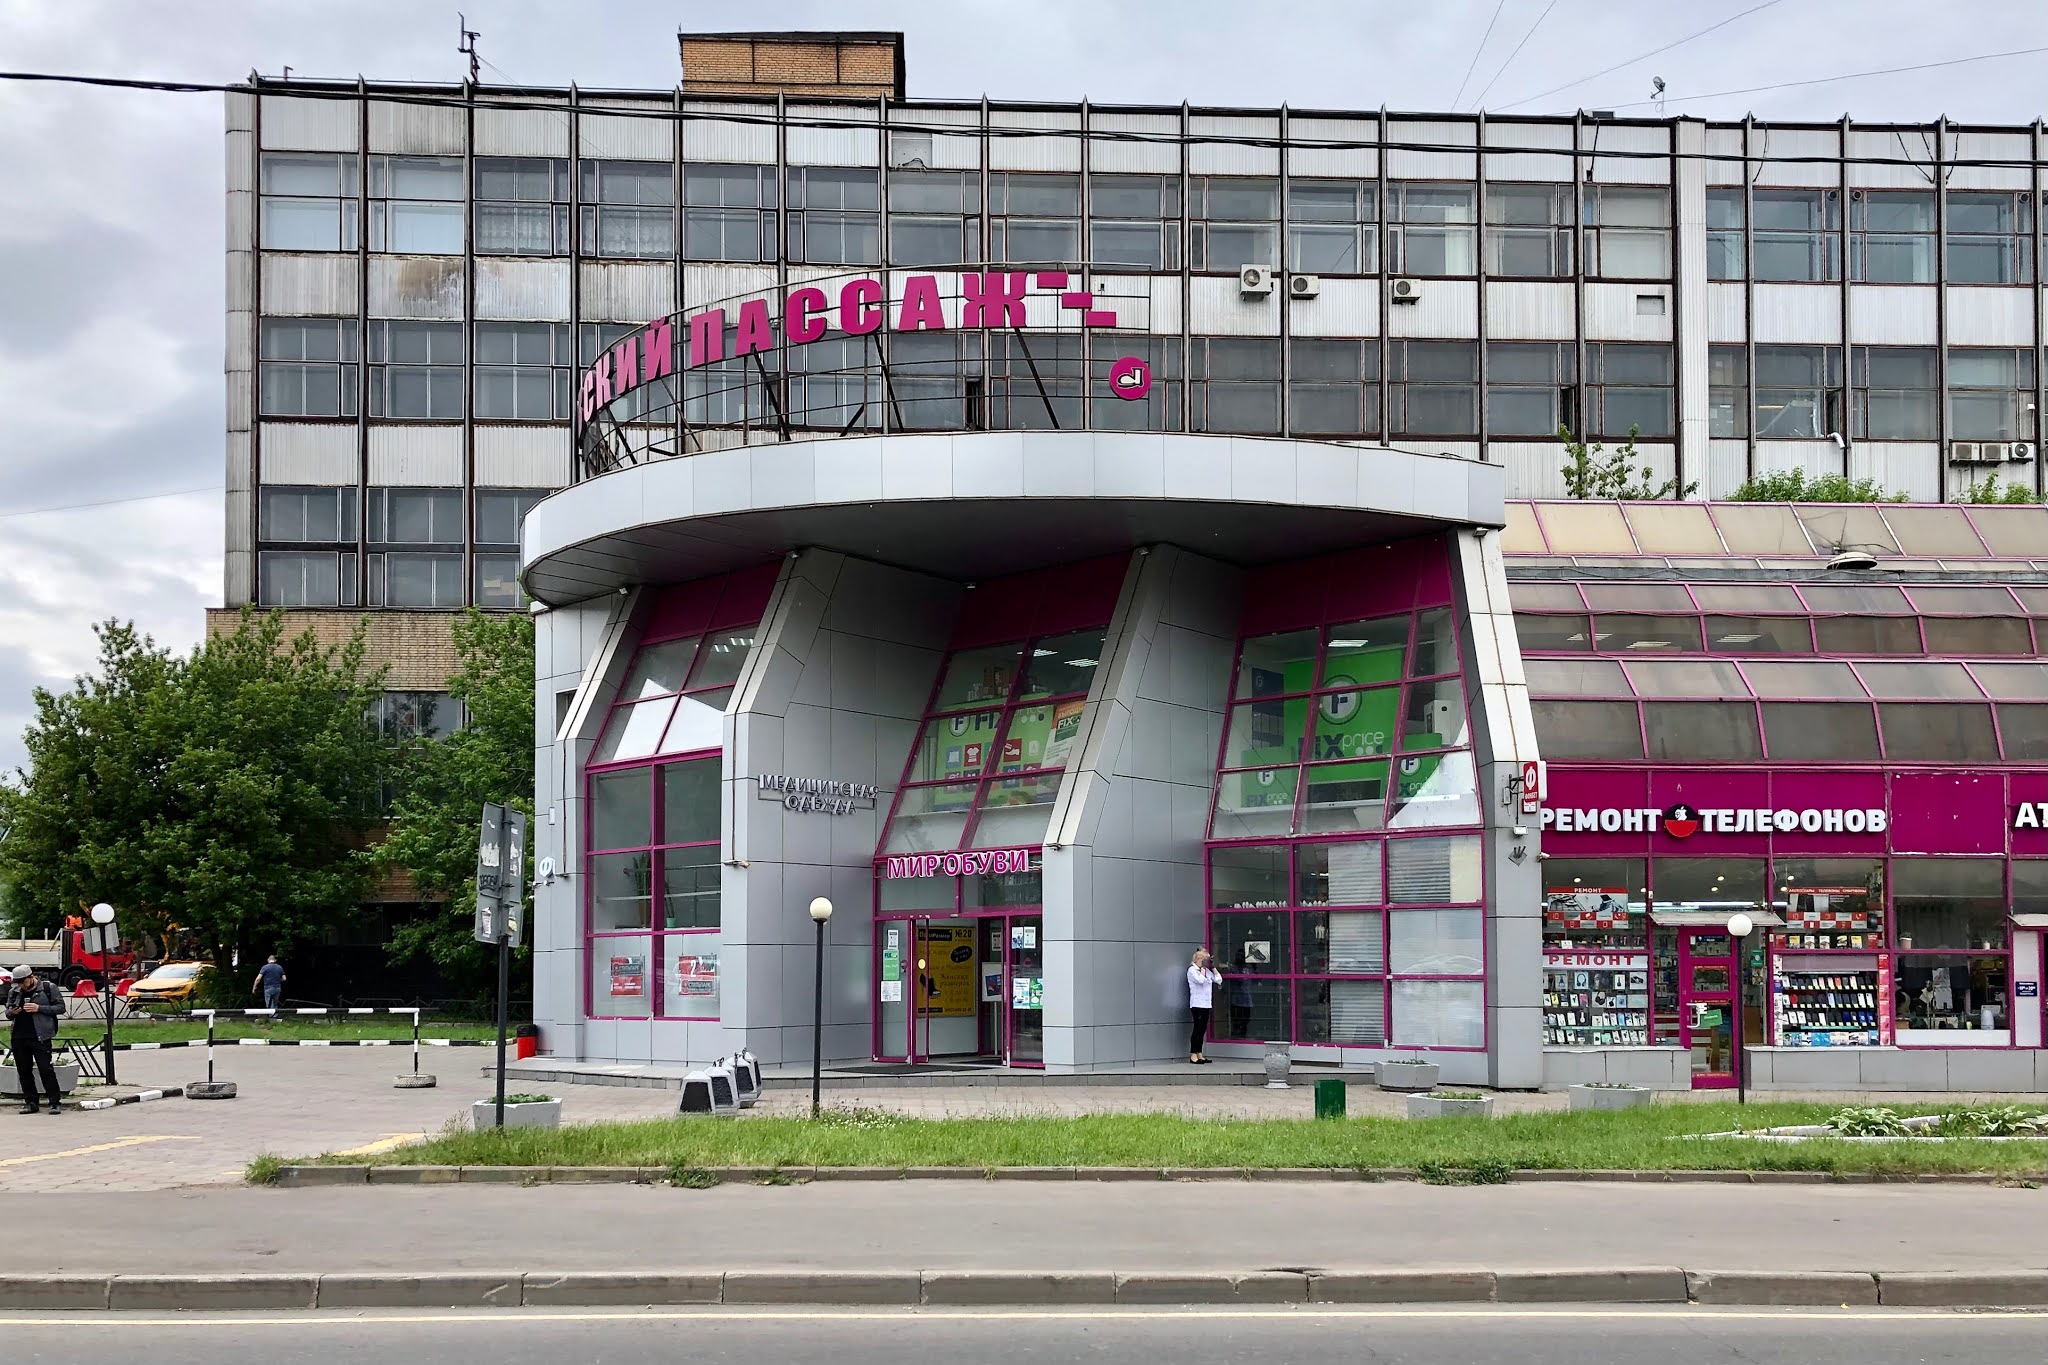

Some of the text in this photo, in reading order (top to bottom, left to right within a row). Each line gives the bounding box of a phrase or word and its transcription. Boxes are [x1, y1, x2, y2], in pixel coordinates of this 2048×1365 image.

[691, 272, 1027, 368] ПАССАЖ
[1342, 731, 1384, 751] price
[784, 795, 857, 815] ОДЕЖДА
[1540, 808, 1887, 833] РЕМОНТ ТЕЛЕФОНОВ
[887, 850, 1029, 879] МИР ОБУВИ
[1548, 954, 1635, 966] РЕМОНТ
